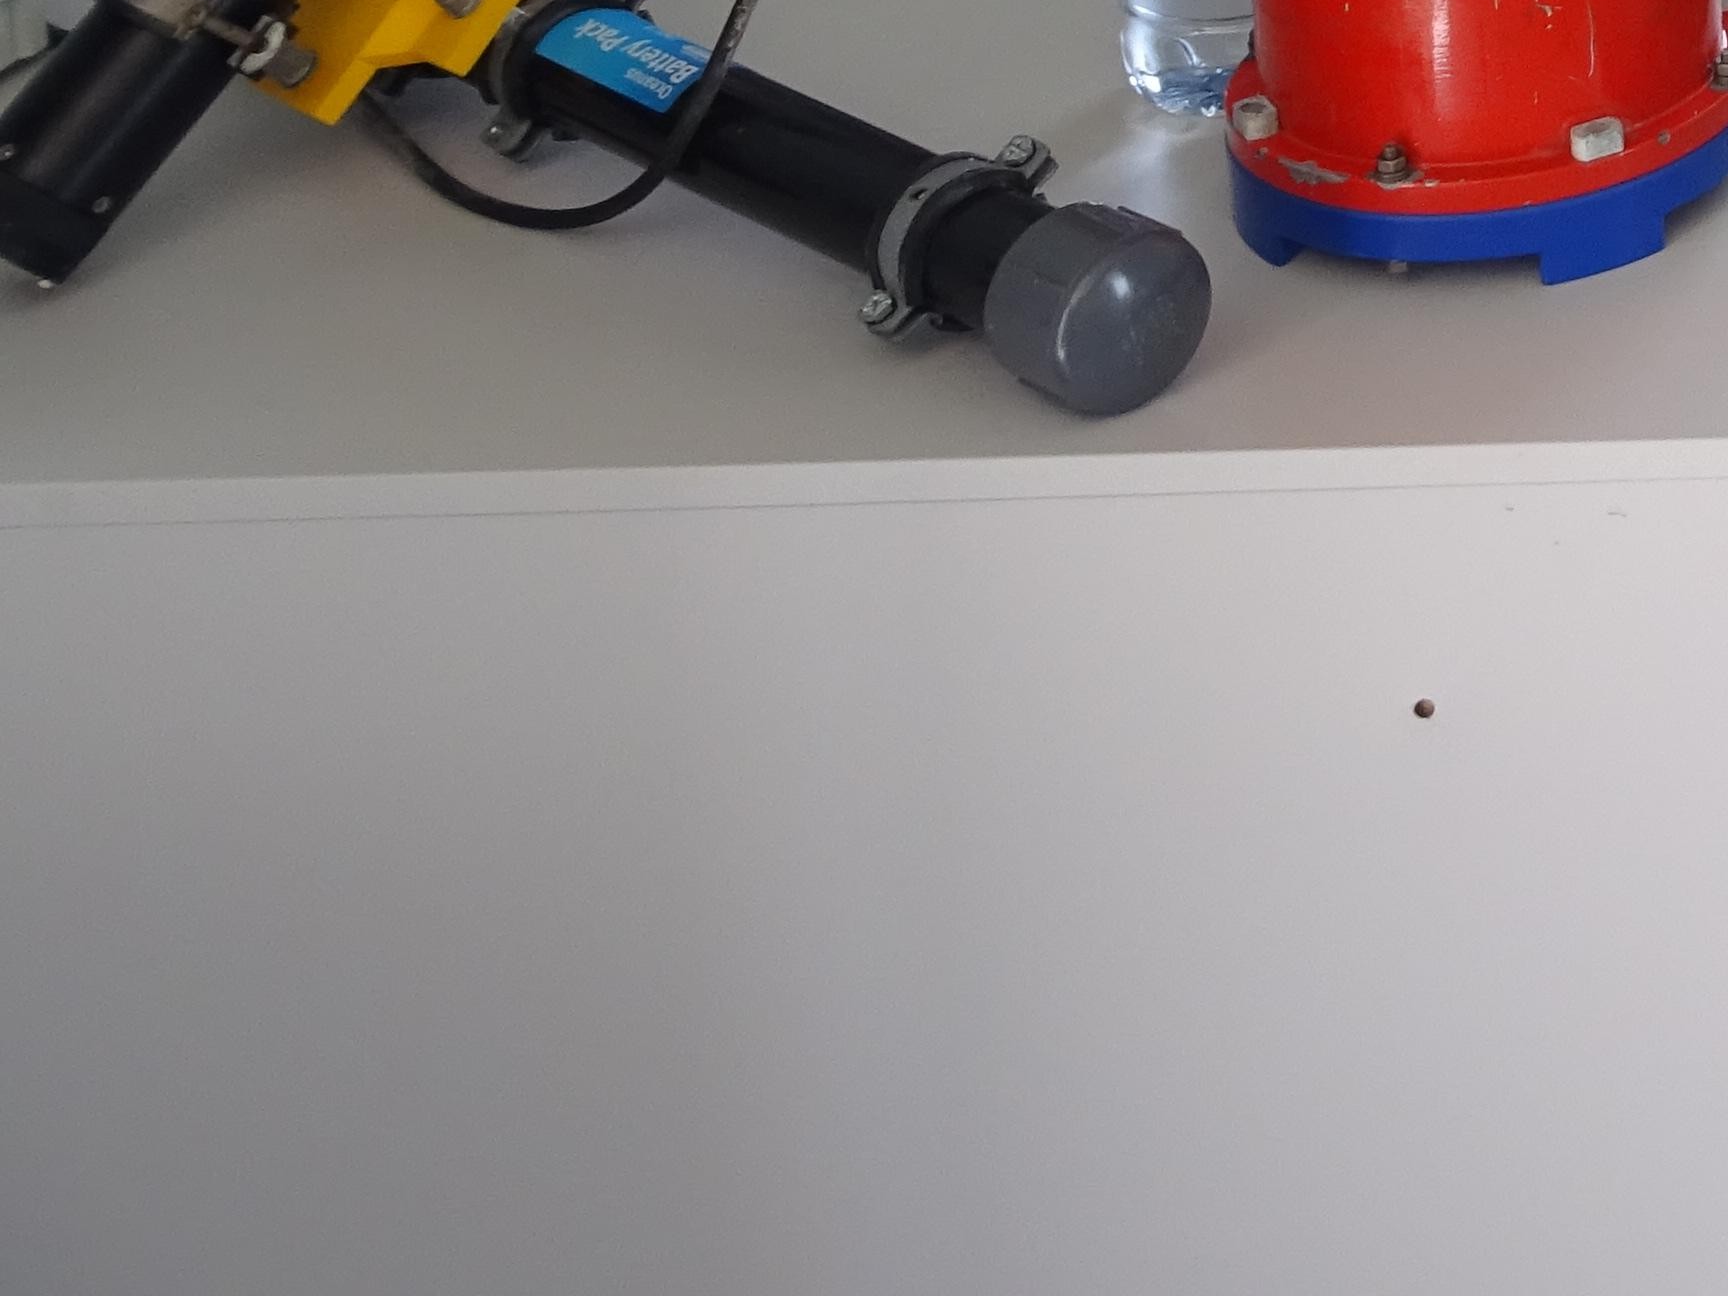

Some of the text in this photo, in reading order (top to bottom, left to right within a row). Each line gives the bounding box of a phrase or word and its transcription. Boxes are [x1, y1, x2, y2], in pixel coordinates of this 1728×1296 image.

[573, 18, 699, 84] Battery Pack
[624, 67, 675, 100] Oceanus
